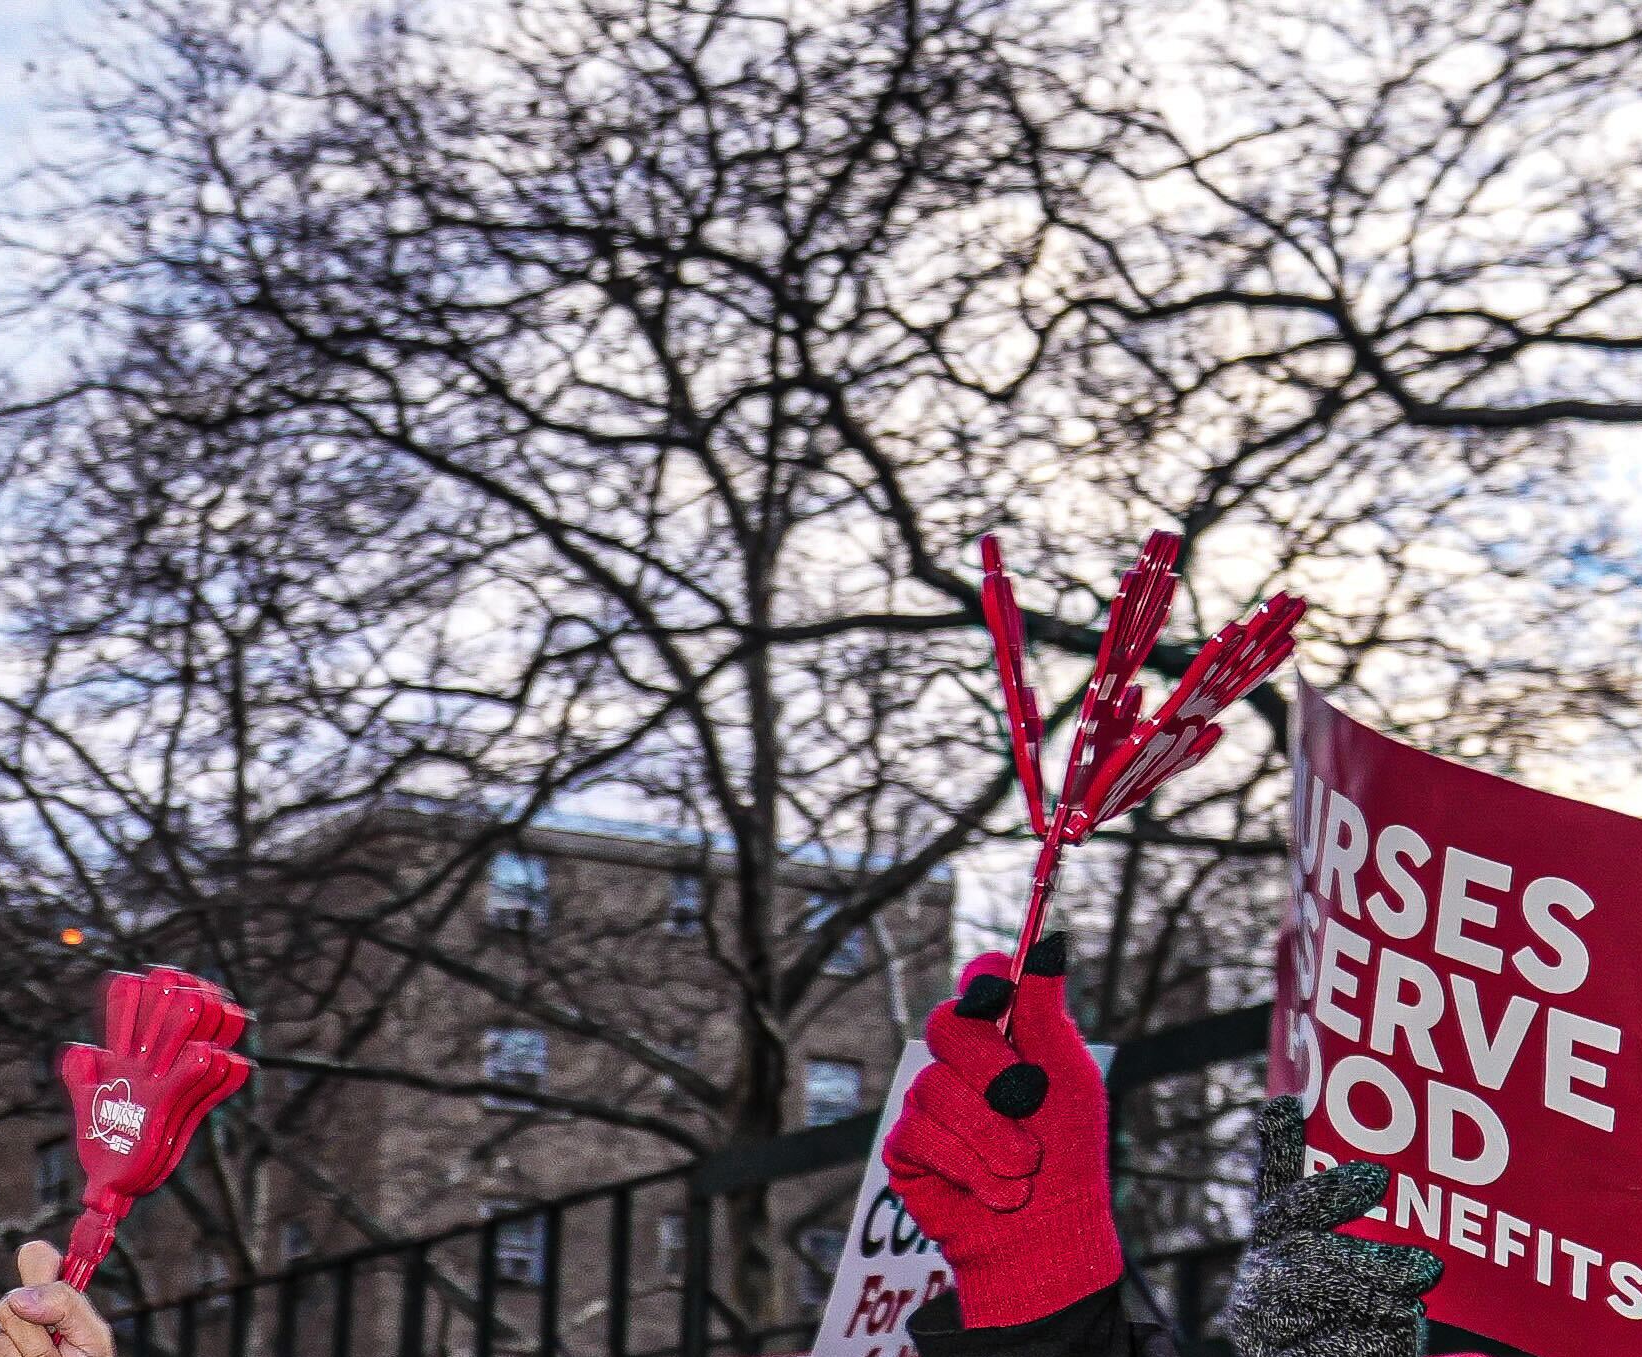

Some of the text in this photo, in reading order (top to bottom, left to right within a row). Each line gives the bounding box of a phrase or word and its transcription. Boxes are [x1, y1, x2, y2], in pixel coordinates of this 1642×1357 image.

[1300, 775, 1596, 995] URSES
[1293, 1008, 1511, 1187] OOD
[1295, 890, 1623, 1133] SERVE
